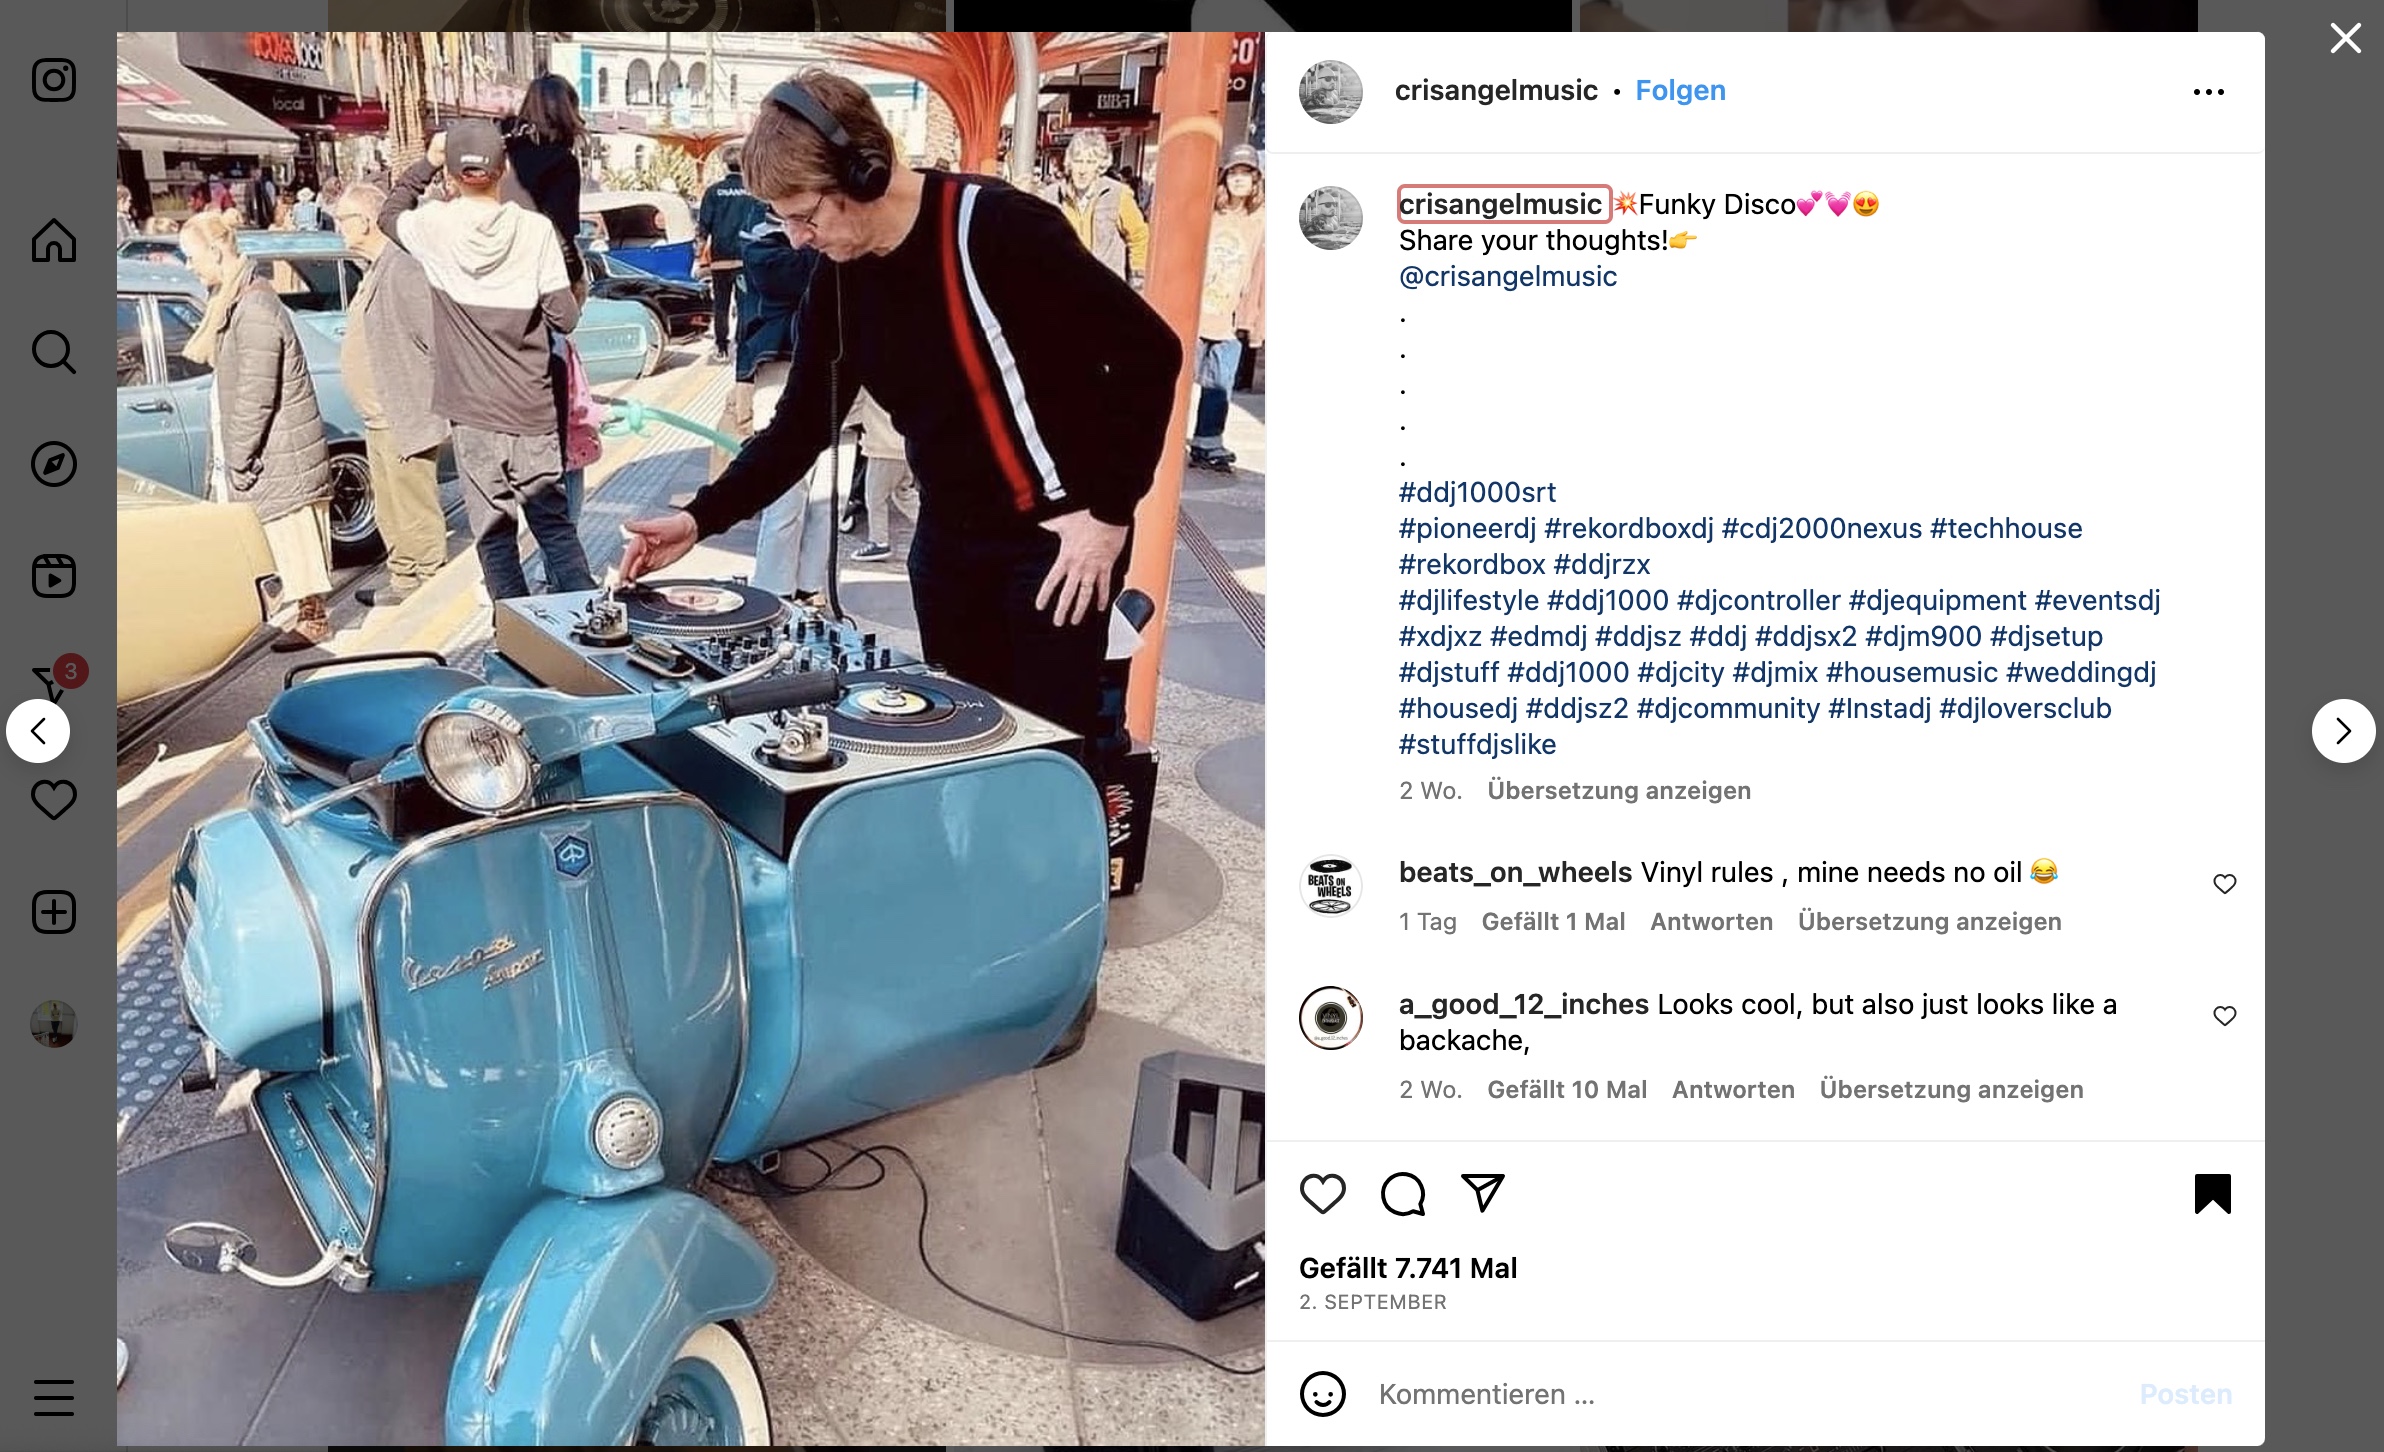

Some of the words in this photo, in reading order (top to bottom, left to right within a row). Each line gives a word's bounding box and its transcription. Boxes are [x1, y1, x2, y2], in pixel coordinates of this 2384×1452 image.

[1396, 78, 1598, 105] crisangelmusic
[1637, 79, 1725, 105] Folgen
[1400, 192, 1602, 219] crisangelmusic
[1641, 193, 1716, 219] Funky
[1726, 193, 1796, 215] Disco
[1400, 229, 1472, 251] Share
[1481, 234, 1538, 255] your
[1546, 229, 1668, 255] thoughts!
[1400, 265, 1617, 291] @crisangelmusic
[1399, 481, 1556, 507] #ddj1000srt
[1399, 517, 1535, 543] #pioneerdj
[1544, 517, 1713, 543] #rekordboxdj
[1722, 517, 1922, 543] #cdj2000nexus
[1930, 517, 2082, 538] #techhouse
[1399, 553, 1545, 574] #rekordbox
[1554, 553, 1650, 579] #ddjrzx
[1399, 589, 1539, 615] #djlifestyle
[1547, 589, 1668, 615] #ddj1000
[1677, 589, 1841, 615] #djcontroller
[1849, 589, 2026, 615] #djequipment
[2035, 589, 2160, 615] #eventsdj
[1399, 625, 1481, 651] #xdjxz
[1490, 625, 1586, 651] #edmdj
[1595, 625, 1681, 651] #ddjsz
[1690, 625, 1746, 651] #ddj
[1755, 625, 1856, 651] #ddjsx2
[1865, 625, 1981, 651] #djm900
[1990, 625, 2103, 651] #djsetup
[65, 662, 77, 680] 3
[1399, 661, 1499, 687] #djstuff
[1507, 661, 1629, 687] #ddj1000
[1637, 661, 1724, 687] #djcity
[1733, 661, 1818, 687] #djmix
[1826, 661, 1998, 682] #housemusic
[2006, 661, 2155, 687] #weddingdj
[1399, 697, 1517, 723] #housedj
[1526, 697, 1628, 723] #ddjsz2
[1637, 697, 1820, 723] #djcommunity
[1828, 697, 1930, 723] #Instadj
[1939, 697, 2111, 723] #djloversclub
[1399, 733, 1556, 759] #stuffdjslike
[1401, 781, 1412, 799] 2
[1421, 782, 1461, 799] Wo.
[1489, 777, 1638, 803] Übersetzung
[1646, 780, 1750, 803] anzeigen
[1308, 874, 1334, 886] BEATS
[1336, 877, 1346, 886] ON
[1401, 861, 1632, 887] beats_on_wheels
[1641, 861, 1701, 887] Vinyl
[1712, 861, 1773, 882] rules
[1799, 861, 1858, 882] mine
[1869, 861, 1945, 882] needs
[1955, 866, 1985, 882] no
[1994, 861, 2021, 882] oil
[1317, 885, 1352, 898] WHEELS
[1400, 913, 1407, 930] 1
[1418, 913, 1456, 934] Tag
[1483, 912, 1559, 930] Gefällt
[1567, 913, 1575, 930] 1
[1586, 912, 1624, 930] Mal
[1651, 913, 1772, 930] Antworten
[1800, 908, 1948, 934] Übersetzung
[1957, 911, 2061, 934] anzeigen
[1400, 992, 1649, 1019] a_good_12_inches
[1659, 993, 1732, 1014] Looks
[1742, 993, 1802, 1019] cool,
[1813, 993, 1853, 1014] but
[1863, 993, 1913, 1014] also
[1921, 993, 1968, 1019] just
[1978, 993, 2043, 1014] looks
[2053, 993, 2094, 1014] like
[2104, 999, 2116, 1014] a
[1401, 1029, 1529, 1055] backache,
[1401, 1080, 1412, 1098] 2
[1421, 1081, 1461, 1098] Wo.
[1488, 1080, 1564, 1098] Gefällt
[1573, 1080, 1598, 1098] 10
[1608, 1080, 1646, 1098] Mal
[1673, 1081, 1794, 1098] Antworten
[1821, 1076, 1970, 1102] Übersetzung
[1979, 1079, 2083, 1102] anzeigen
[1300, 1256, 1387, 1279] Gefällt
[1396, 1258, 1460, 1278] 7.741
[1472, 1257, 1516, 1278] Mal
[1300, 1294, 1316, 1309] 2.
[1325, 1294, 1446, 1309] SEPTEMBER
[1381, 1383, 1564, 1404] Kommentieren
[2142, 1384, 2232, 1404] Posten
